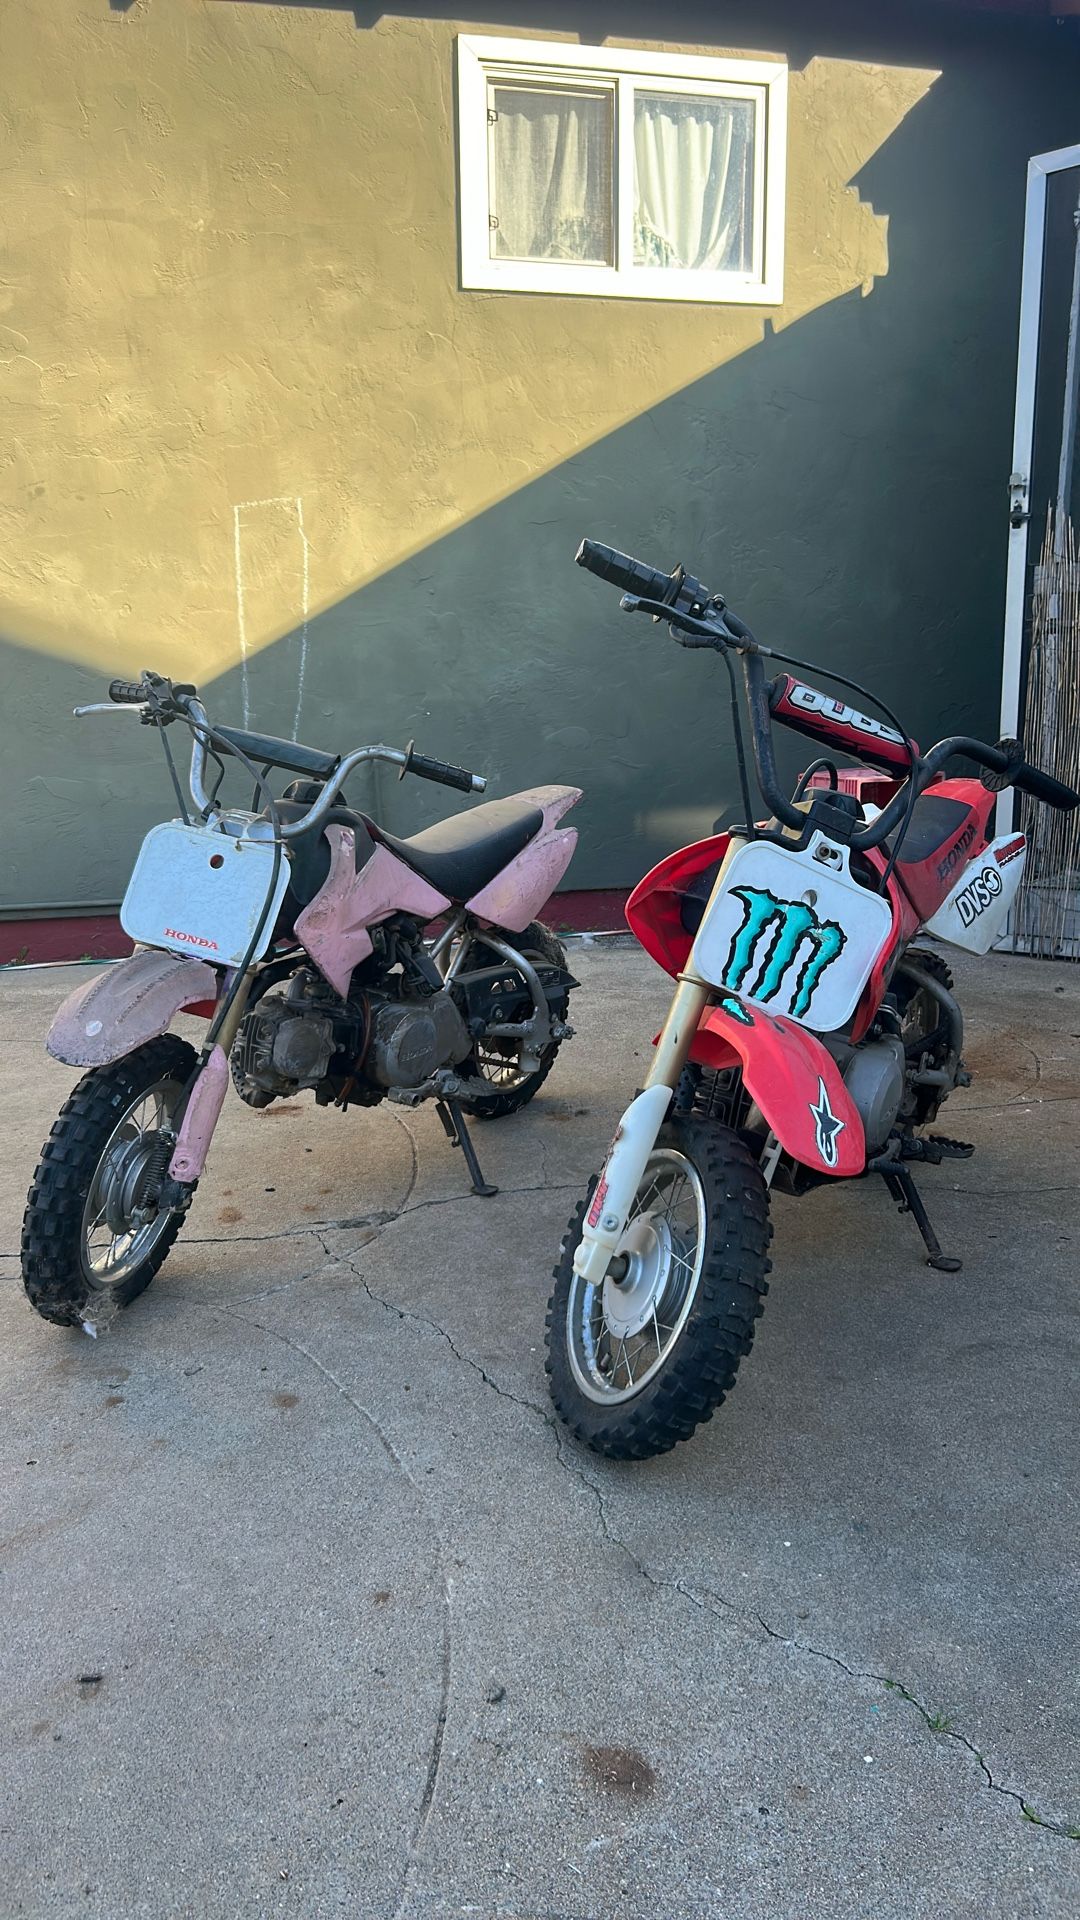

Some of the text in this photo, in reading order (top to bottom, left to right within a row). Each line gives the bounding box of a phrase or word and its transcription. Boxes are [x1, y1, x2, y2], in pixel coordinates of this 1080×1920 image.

[937, 823, 977, 881] HONDA
[955, 876, 993, 928] DVS
[164, 928, 219, 950] HONDA
